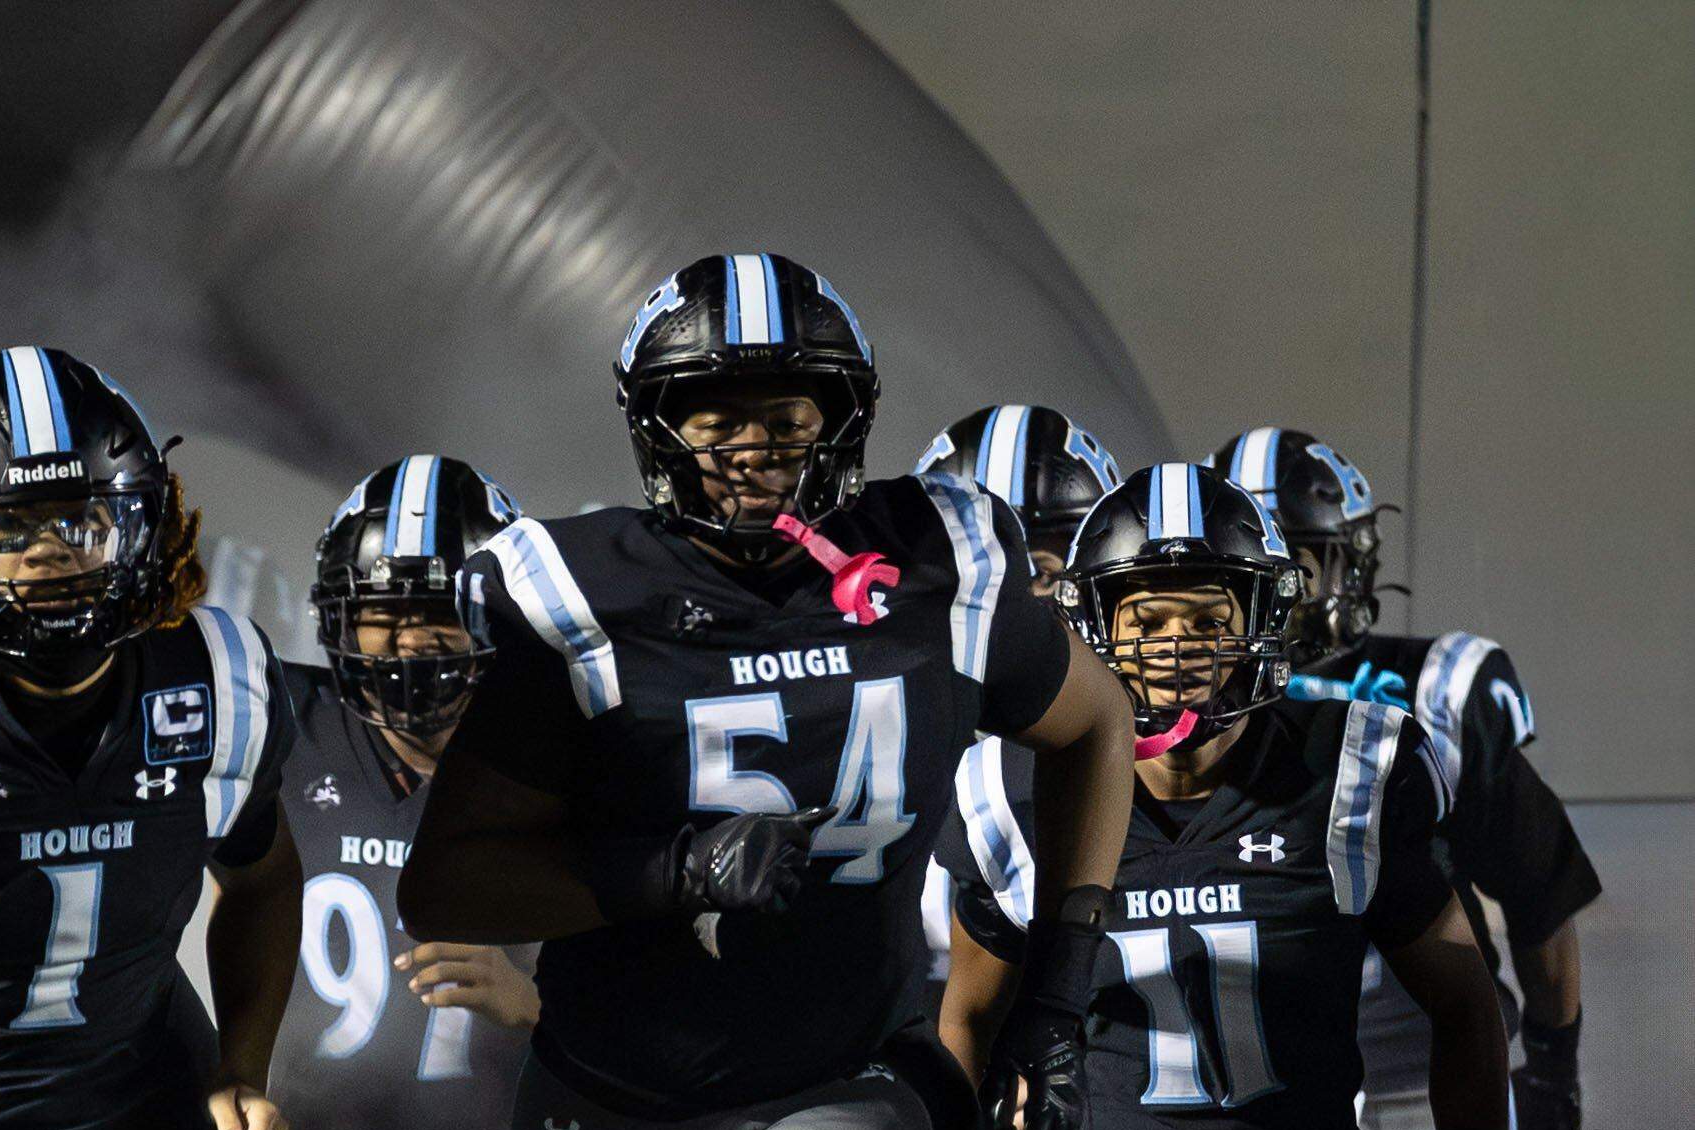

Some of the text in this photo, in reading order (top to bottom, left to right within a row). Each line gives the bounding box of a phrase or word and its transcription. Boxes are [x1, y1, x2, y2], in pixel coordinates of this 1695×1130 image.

[8, 460, 84, 486] Riddell
[729, 646, 853, 685] HOUGH
[152, 690, 204, 736] C
[685, 675, 918, 886] 54
[20, 820, 135, 861] HOUGH
[339, 835, 413, 868] HOU
[1125, 883, 1243, 920] HOUGH
[8, 861, 104, 1030] 1
[1105, 920, 1289, 1110] 11
